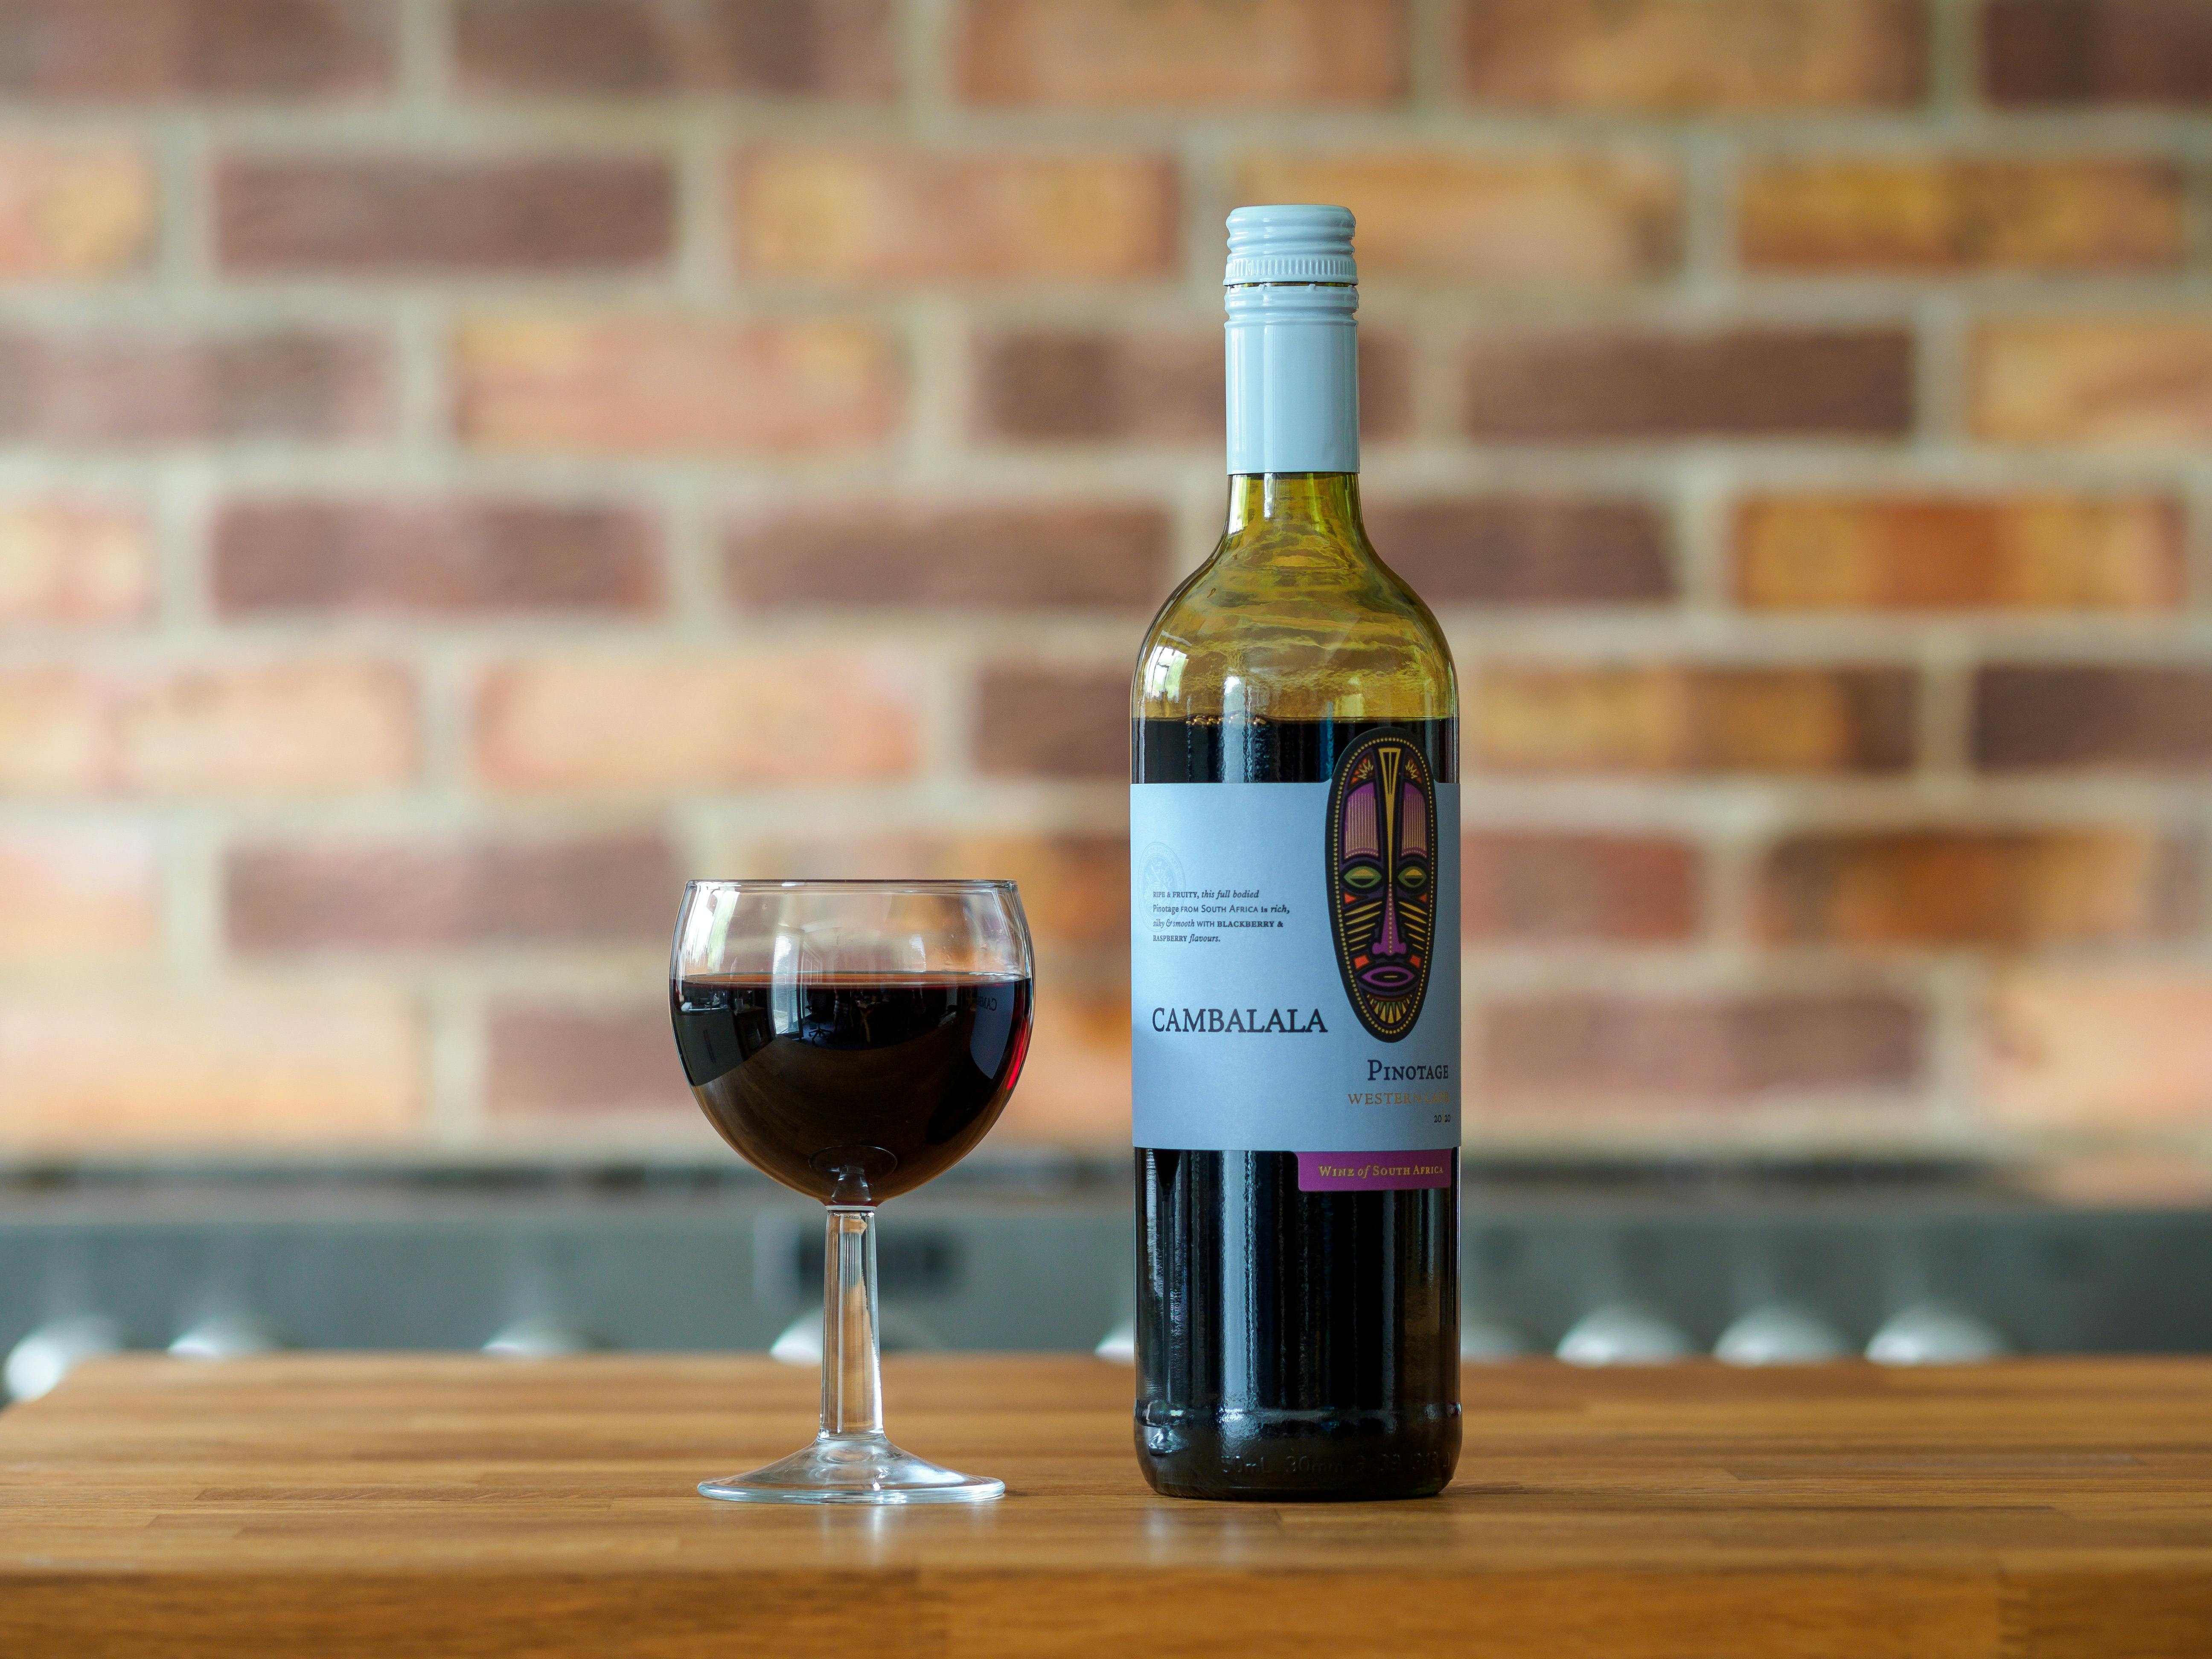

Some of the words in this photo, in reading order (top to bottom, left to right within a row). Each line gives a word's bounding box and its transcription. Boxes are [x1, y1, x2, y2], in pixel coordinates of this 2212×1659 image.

[1201, 890, 1215, 898] this
[1215, 890, 1231, 900] full
[1233, 890, 1260, 898] bodied
[1153, 904, 1179, 915] Pinotage
[1270, 904, 1290, 914] rich,
[1153, 919, 1165, 928] silky
[1173, 919, 1195, 927] smooth
[1188, 933, 1221, 944] flavours.
[1152, 1007, 1328, 1033] CAMBALALA
[1347, 1092, 1422, 1105] WESTERN
[1357, 1165, 1371, 1179] of
